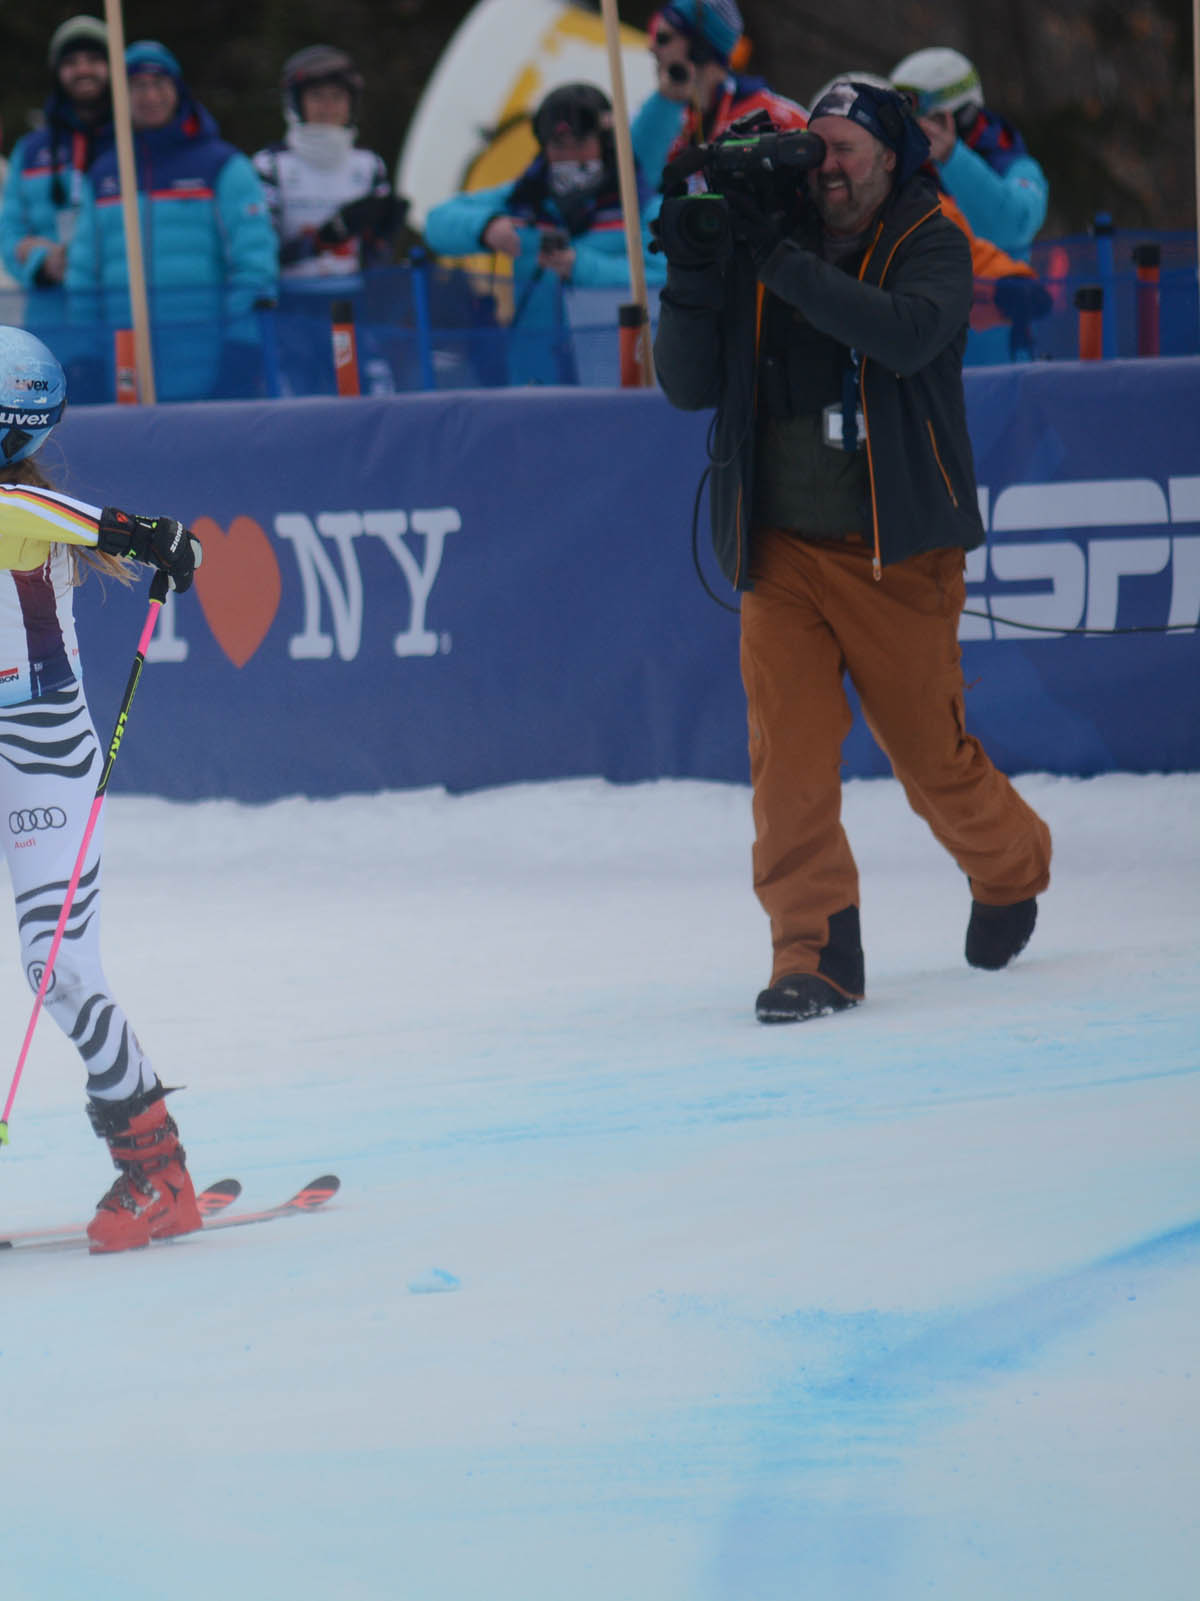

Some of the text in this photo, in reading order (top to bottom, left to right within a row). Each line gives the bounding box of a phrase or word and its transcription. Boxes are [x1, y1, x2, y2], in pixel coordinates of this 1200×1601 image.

[274, 508, 461, 662] NY
[957, 475, 1200, 642] SP
[14, 838, 36, 850] Audi
